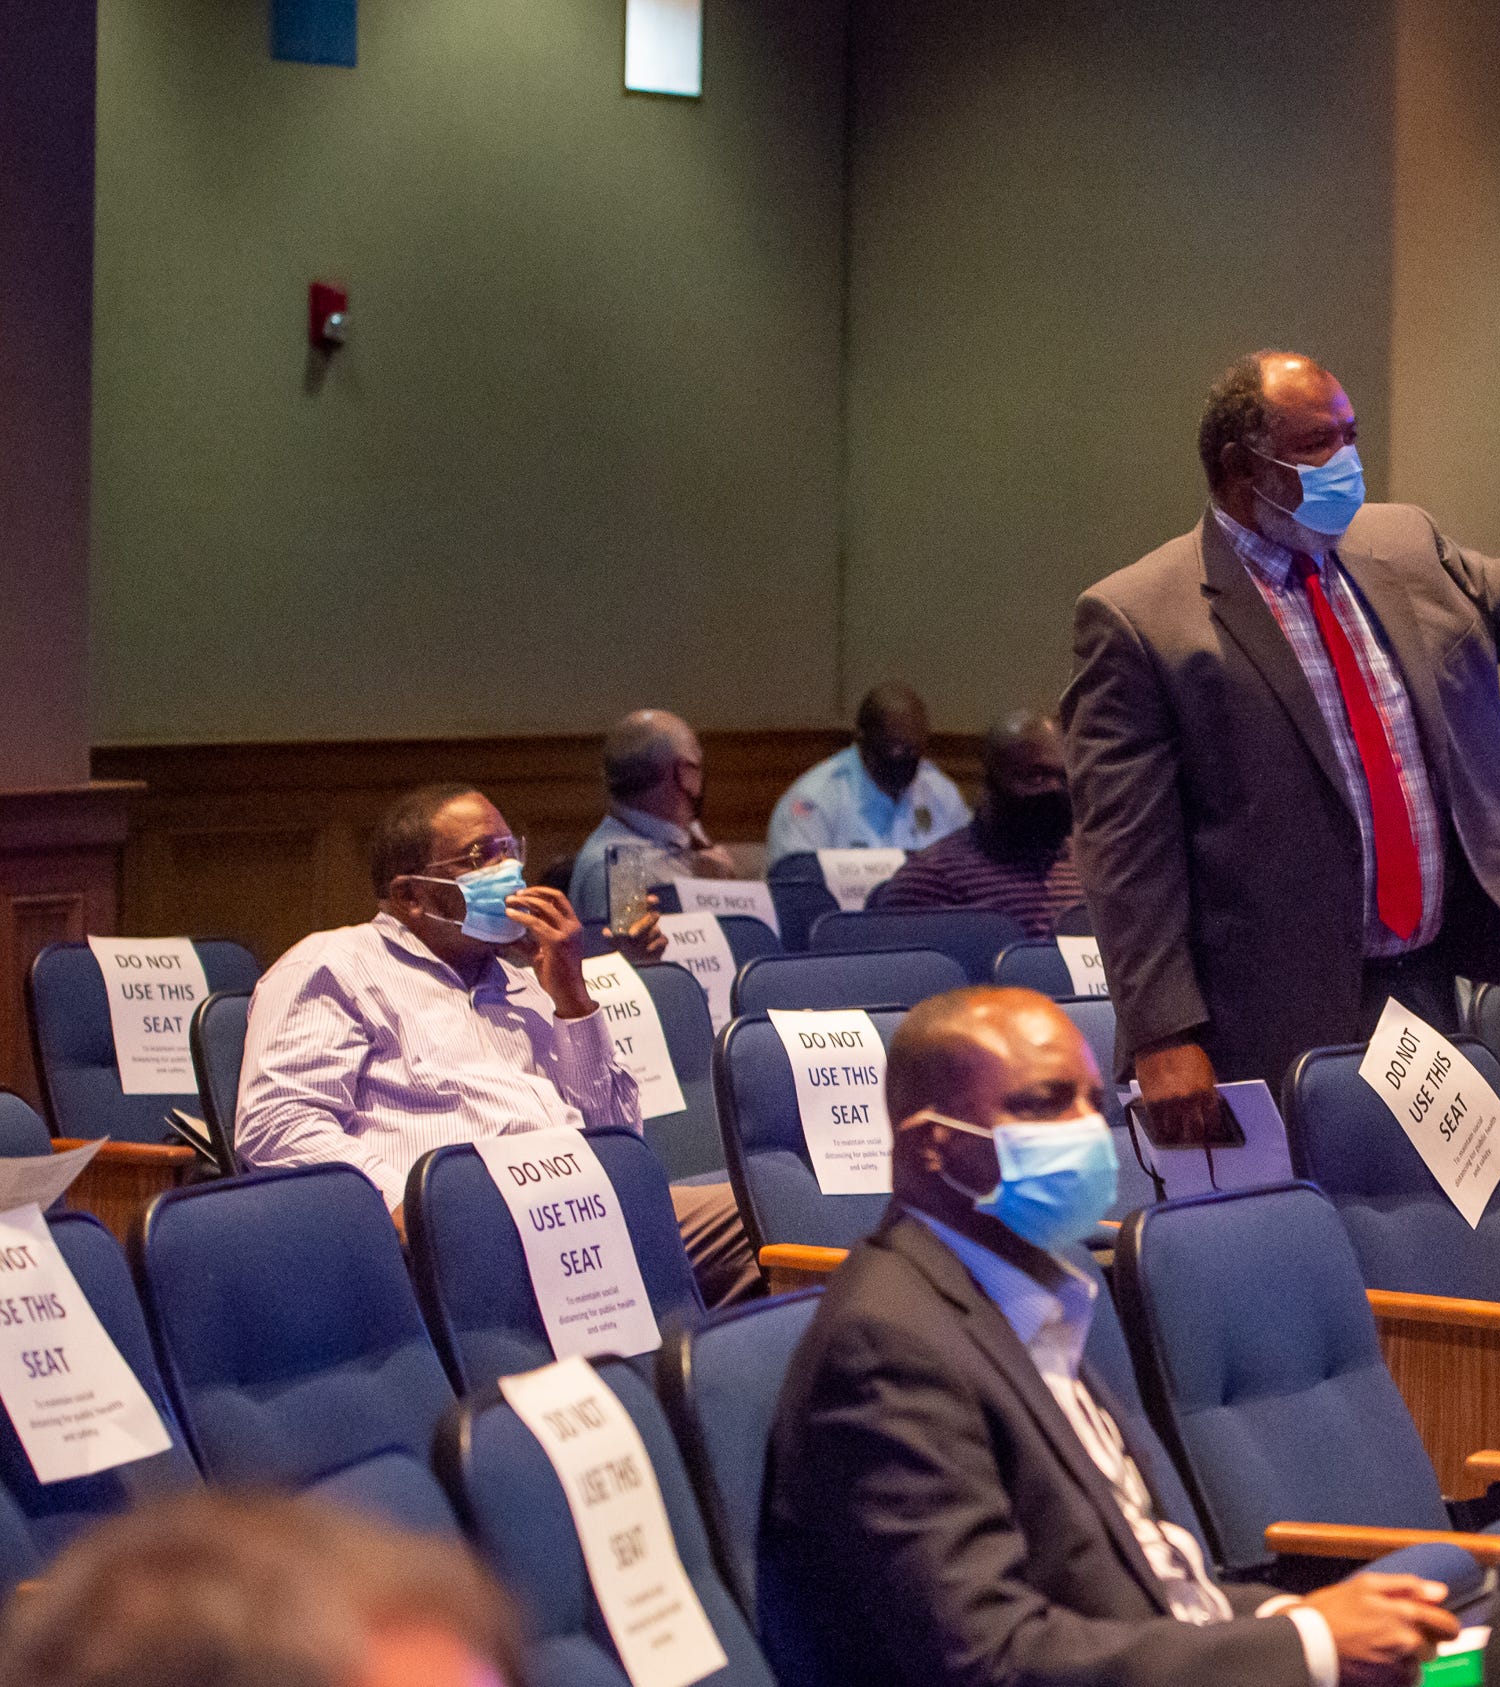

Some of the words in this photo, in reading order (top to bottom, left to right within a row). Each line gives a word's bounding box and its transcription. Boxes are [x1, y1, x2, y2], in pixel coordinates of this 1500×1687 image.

[696, 895, 720, 907] DO
[724, 896, 754, 909] NOT
[673, 930, 706, 946] NOT
[114, 954, 142, 969] DO
[145, 954, 182, 970] NOT
[686, 955, 720, 973] THIS
[121, 983, 153, 1000] USE
[157, 984, 195, 1001] THIS
[585, 973, 621, 991] NOT
[602, 1000, 641, 1023] THIS
[143, 1016, 183, 1033] SEAT
[798, 1032, 826, 1049] DO
[828, 1031, 864, 1048] NOT
[1385, 1061, 1406, 1090] DO
[1396, 1027, 1421, 1065] NOT
[808, 1067, 840, 1087] USE
[842, 1066, 878, 1086] THIS
[1408, 1084, 1435, 1124] USE
[1426, 1051, 1452, 1090] THIS
[831, 1105, 869, 1125] SEAT
[1439, 1092, 1468, 1142] SEAT
[508, 1162, 541, 1186] DO
[539, 1153, 582, 1180] NOT
[529, 1203, 566, 1232] USE
[565, 1194, 606, 1224] THIS
[560, 1245, 603, 1277] SEAT
[0, 1299, 23, 1327] SE
[22, 1293, 66, 1322] THIS
[587, 1325, 599, 1334] and
[22, 1348, 71, 1378] SEAT
